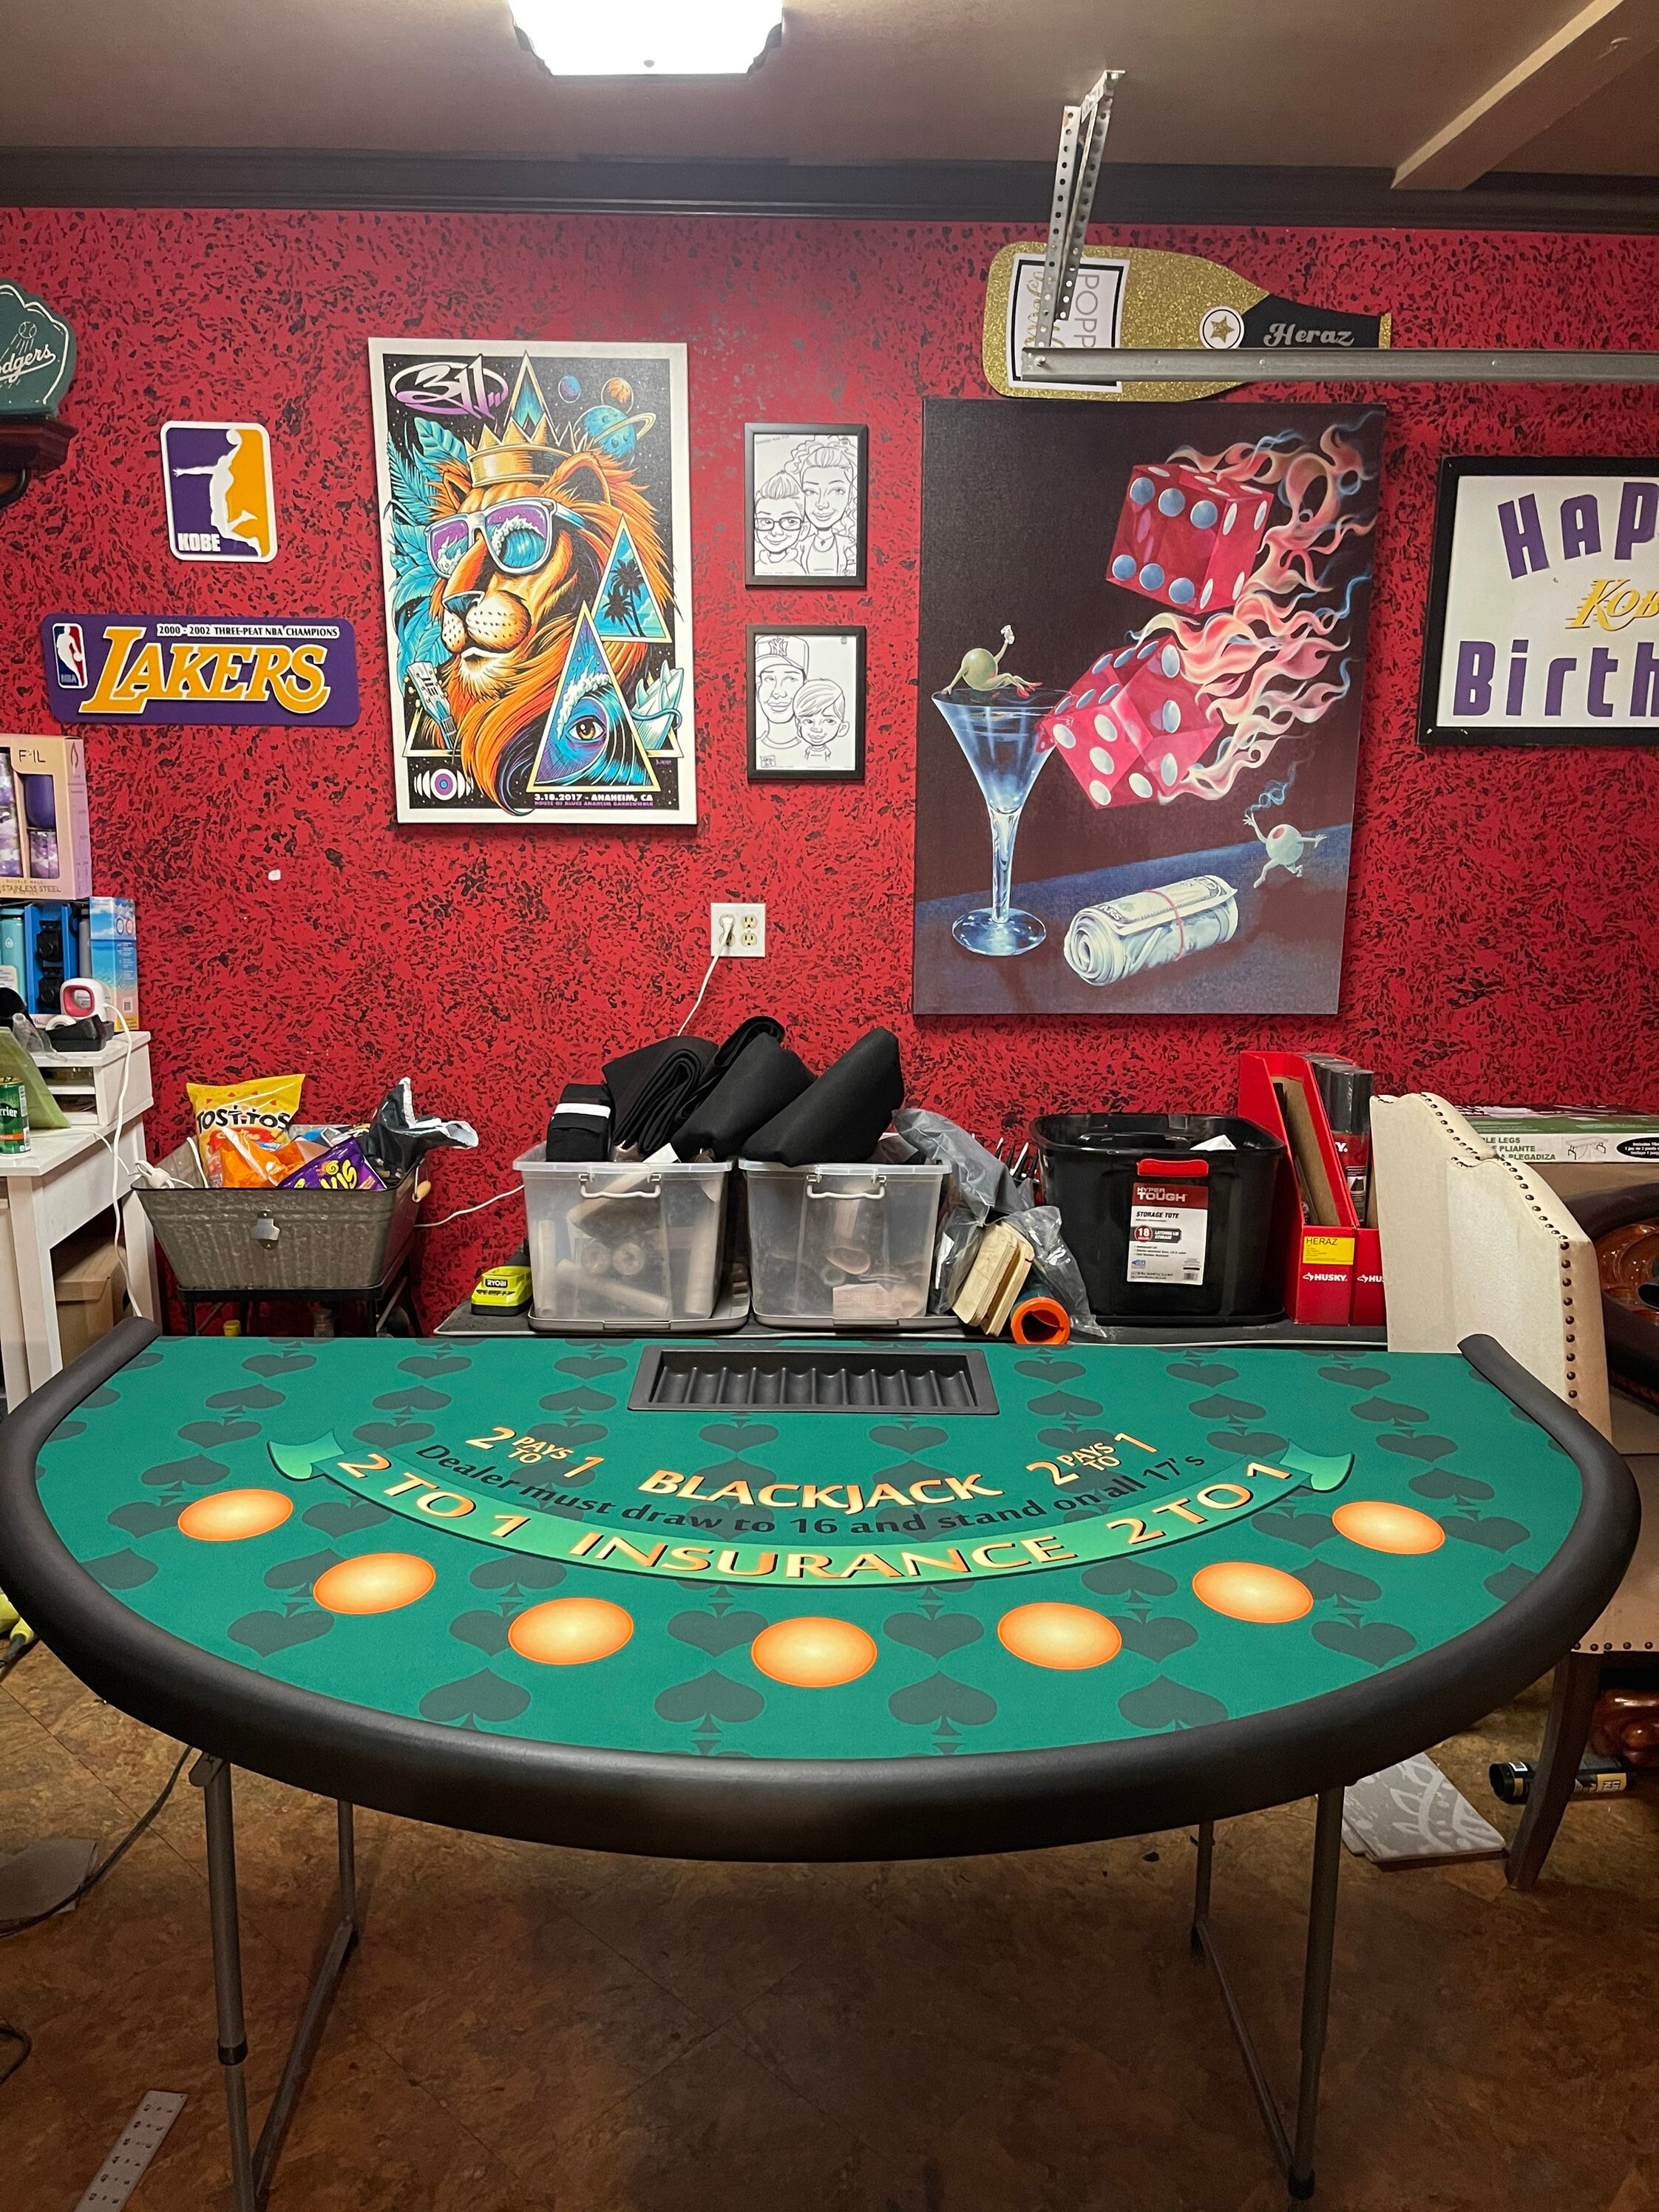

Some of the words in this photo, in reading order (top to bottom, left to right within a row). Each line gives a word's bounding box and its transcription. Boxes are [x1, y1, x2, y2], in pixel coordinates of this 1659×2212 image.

[1263, 322, 1355, 347] Heraz
[0, 343, 56, 384] dgers
[177, 532, 221, 552] KOBE
[159, 625, 181, 634] 2000
[189, 626, 211, 635] 2002
[214, 627, 263, 636] THREE-PEAT
[265, 628, 283, 636] NBA
[285, 628, 338, 637] CHAMPIONS
[78, 625, 330, 714] LAKERS
[534, 793, 583, 801] 3.18.2017
[591, 794, 638, 802] ANAHEIM,
[0, 1106, 18, 1118] rrier
[197, 1105, 289, 1134] TOSTITOS
[1137, 1192, 1186, 1202] TOUGH
[1138, 1227, 1150, 1237] 18
[1306, 1237, 1338, 1246] HERAZ
[486, 1279, 507, 1287] RYOBI
[464, 1426, 517, 1451] 2
[511, 1435, 574, 1461] PAYS
[1113, 1431, 1158, 1454] 1
[506, 1447, 543, 1465] TO
[1056, 1441, 1116, 1468] PAYS
[1083, 1455, 1122, 1472] TO
[563, 1456, 605, 1479] 1
[1025, 1459, 1079, 1486] 2
[415, 1443, 520, 1489] Dealer
[520, 1482, 618, 1516] must
[621, 1503, 722, 1530] draw
[733, 1516, 776, 1533] to
[789, 1517, 837, 1534] 16
[849, 1513, 926, 1534] and
[937, 1496, 1048, 1529] stand
[1054, 1488, 1102, 1511] on
[1099, 1474, 1147, 1503] all
[1141, 1454, 1206, 1482] 17's
[637, 1468, 1005, 1516] BLACKJACK
[337, 1453, 392, 1479] 2
[382, 1471, 477, 1519] TO
[489, 1513, 532, 1539] 1
[568, 1531, 1079, 1579] INSURANCE
[1105, 1517, 1166, 1545] 2
[1150, 1483, 1254, 1524] TO
[1246, 1461, 1294, 1480] 1
